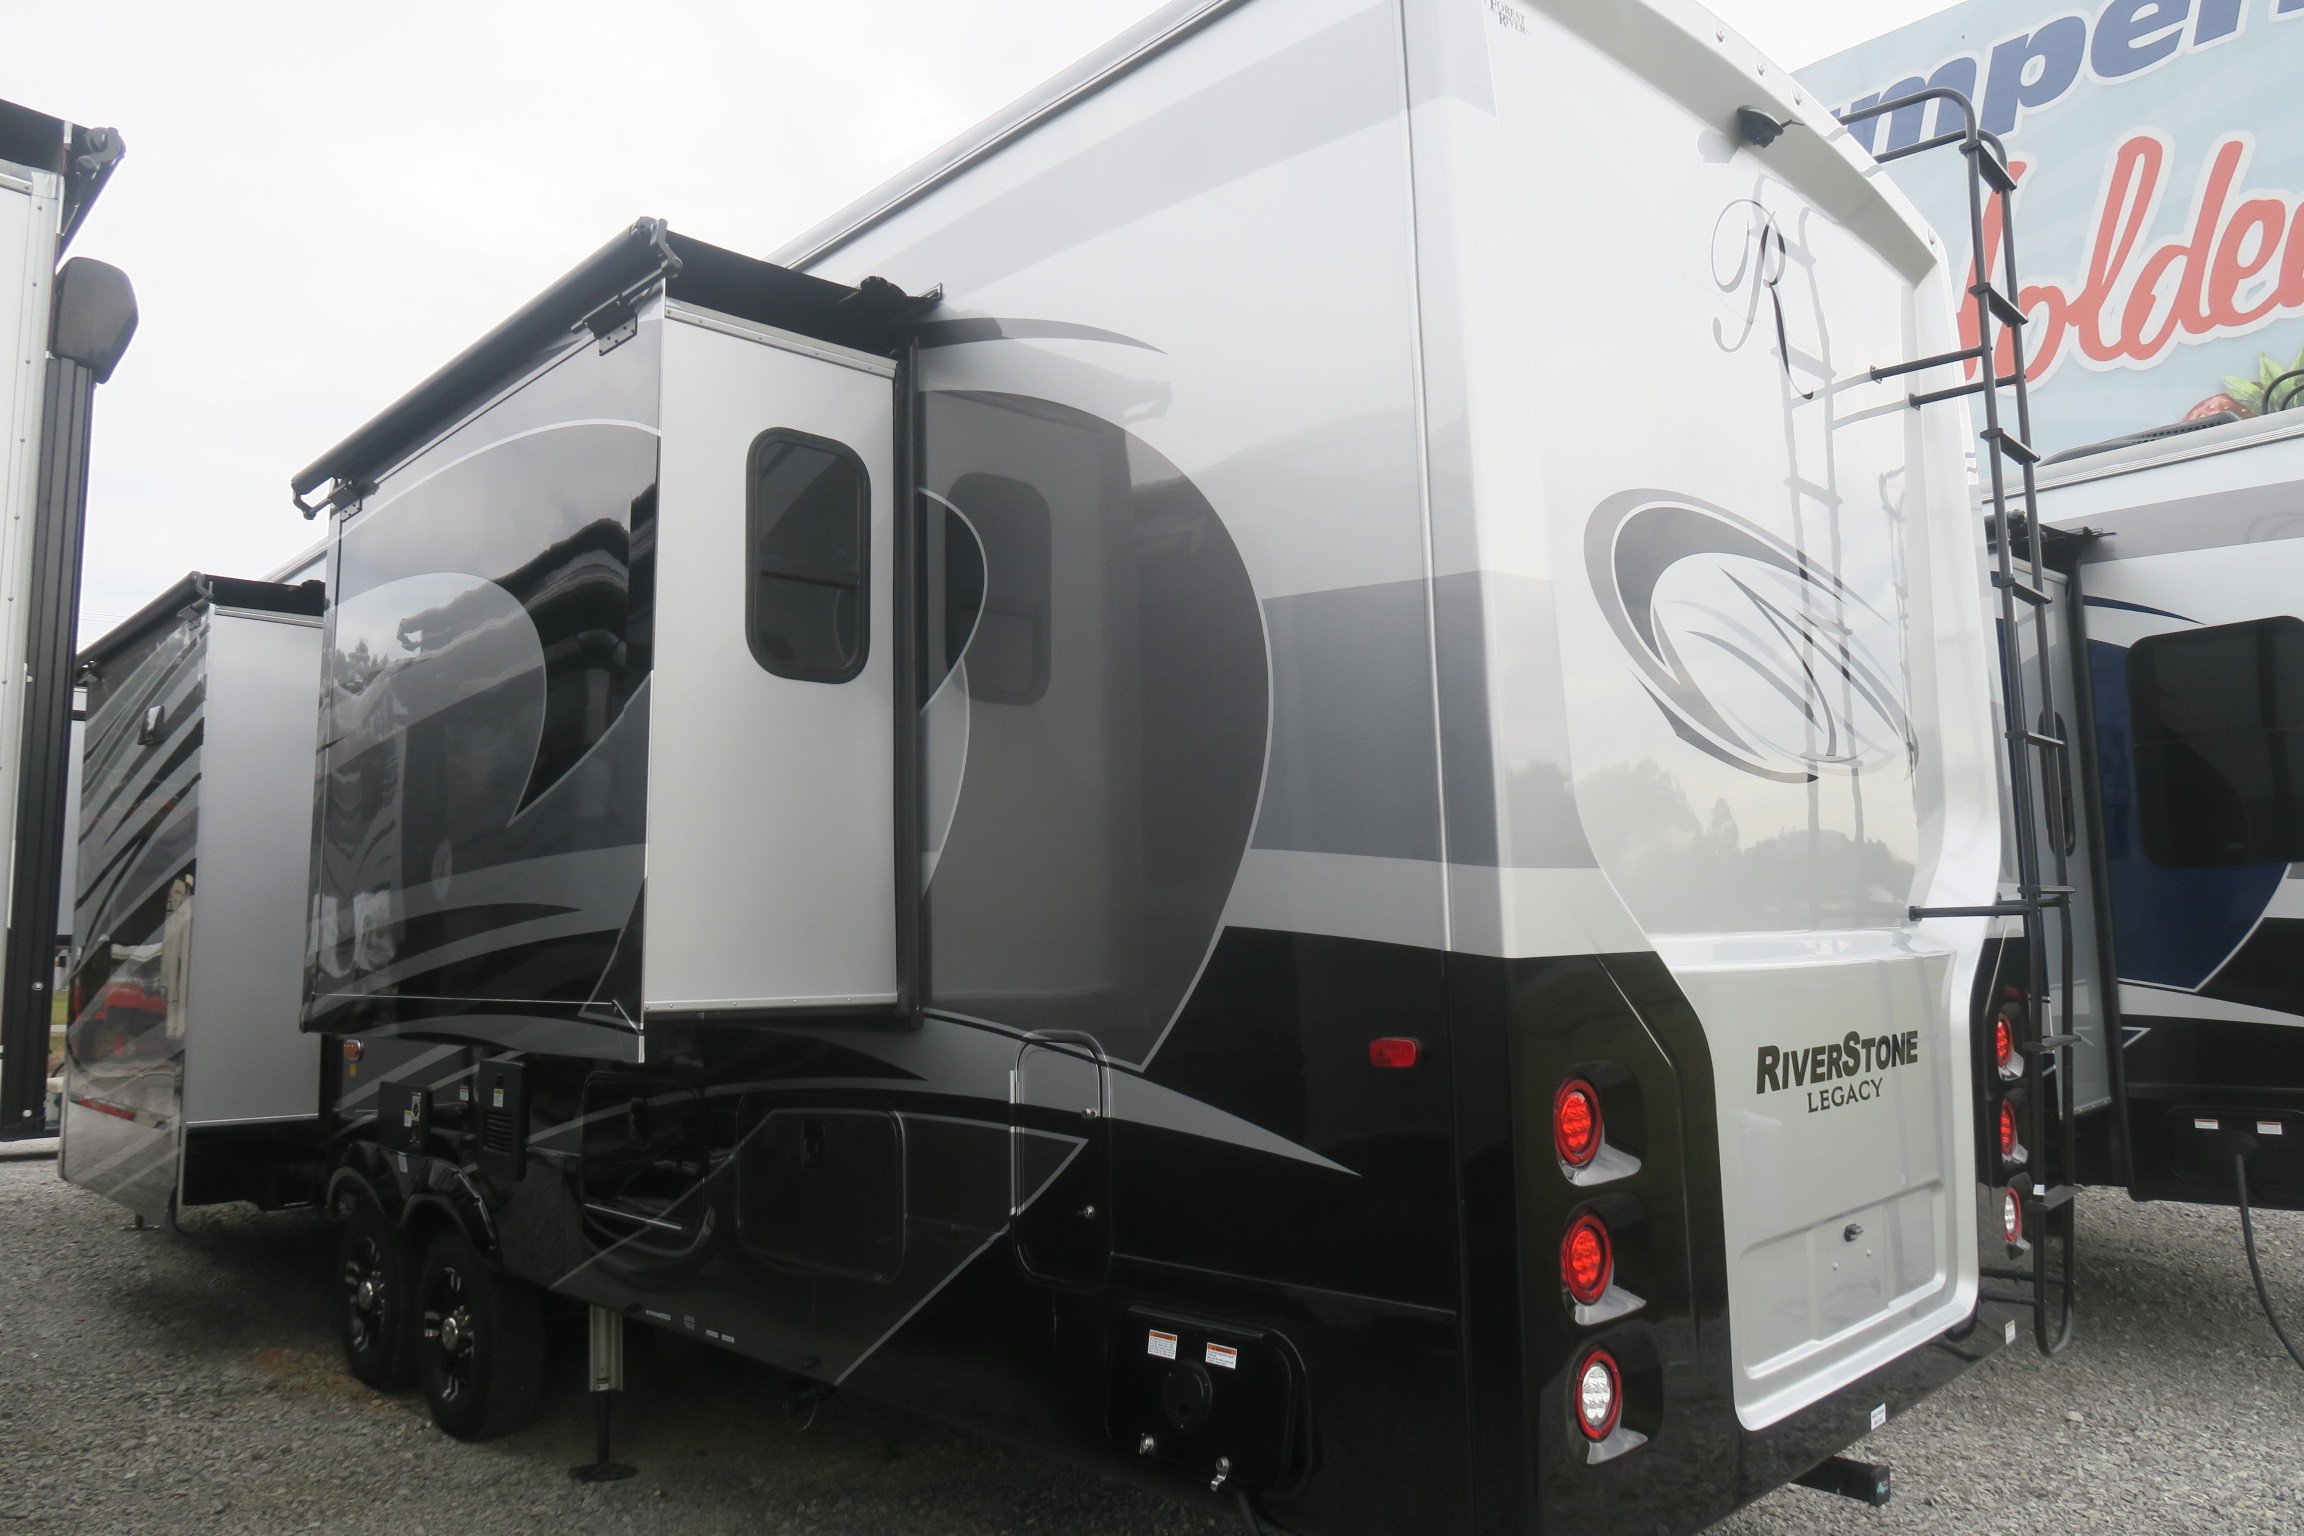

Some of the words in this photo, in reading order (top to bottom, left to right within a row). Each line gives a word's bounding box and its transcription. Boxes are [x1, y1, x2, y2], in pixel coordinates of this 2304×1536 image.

[1489, 0, 1526, 24] FOREST
[1498, 11, 1532, 36] RIVER
[1807, 1077, 1883, 1113] LEGACY
